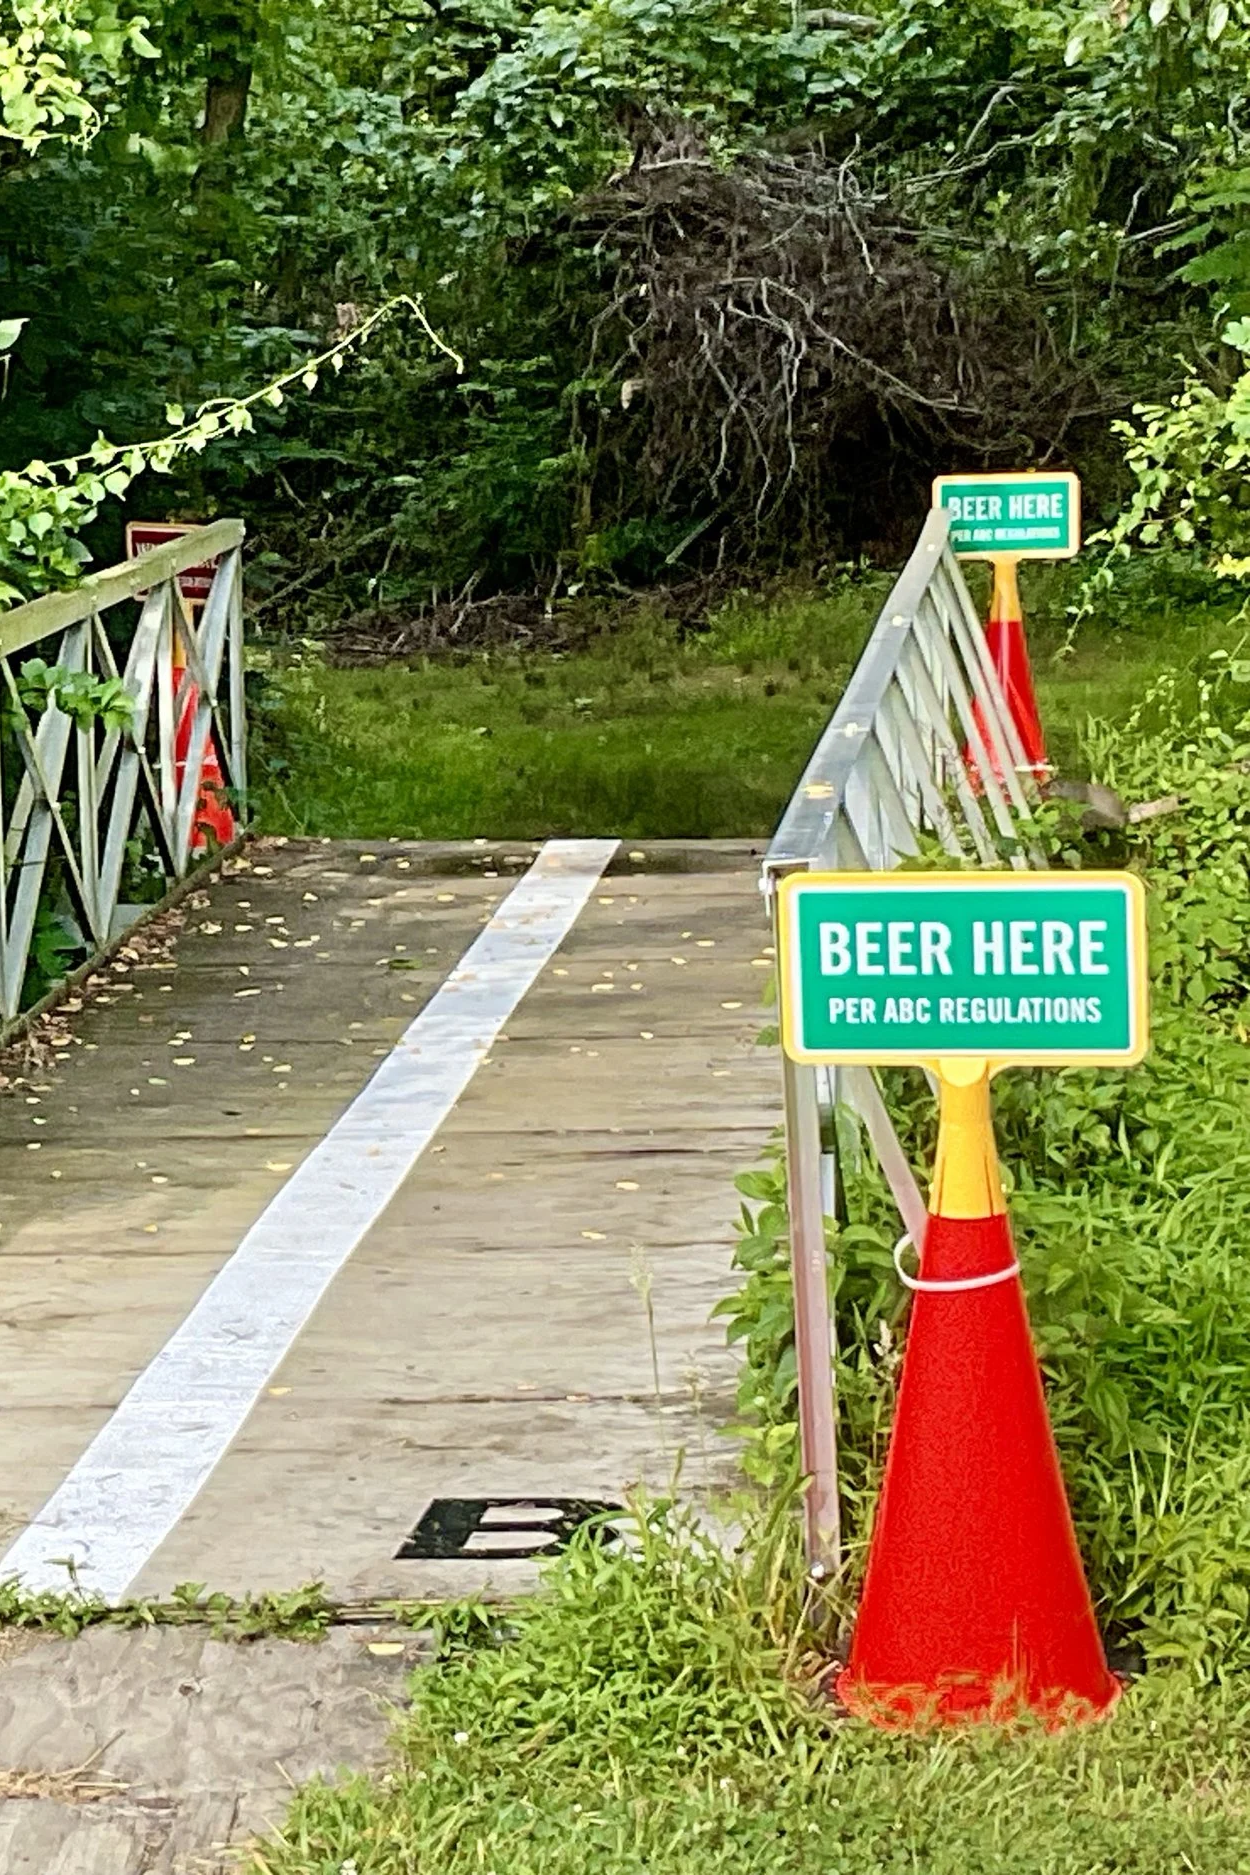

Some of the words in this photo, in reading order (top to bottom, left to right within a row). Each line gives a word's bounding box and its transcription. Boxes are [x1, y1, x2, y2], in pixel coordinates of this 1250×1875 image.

[948, 495, 1002, 521] BEER
[1008, 493, 1063, 520] HERE
[818, 921, 953, 976] BEER
[972, 920, 1109, 976] HERE
[828, 997, 877, 1025] PER
[883, 997, 931, 1025] ABC
[939, 997, 1102, 1025] REGULATIONS
[391, 1498, 625, 1559] B
